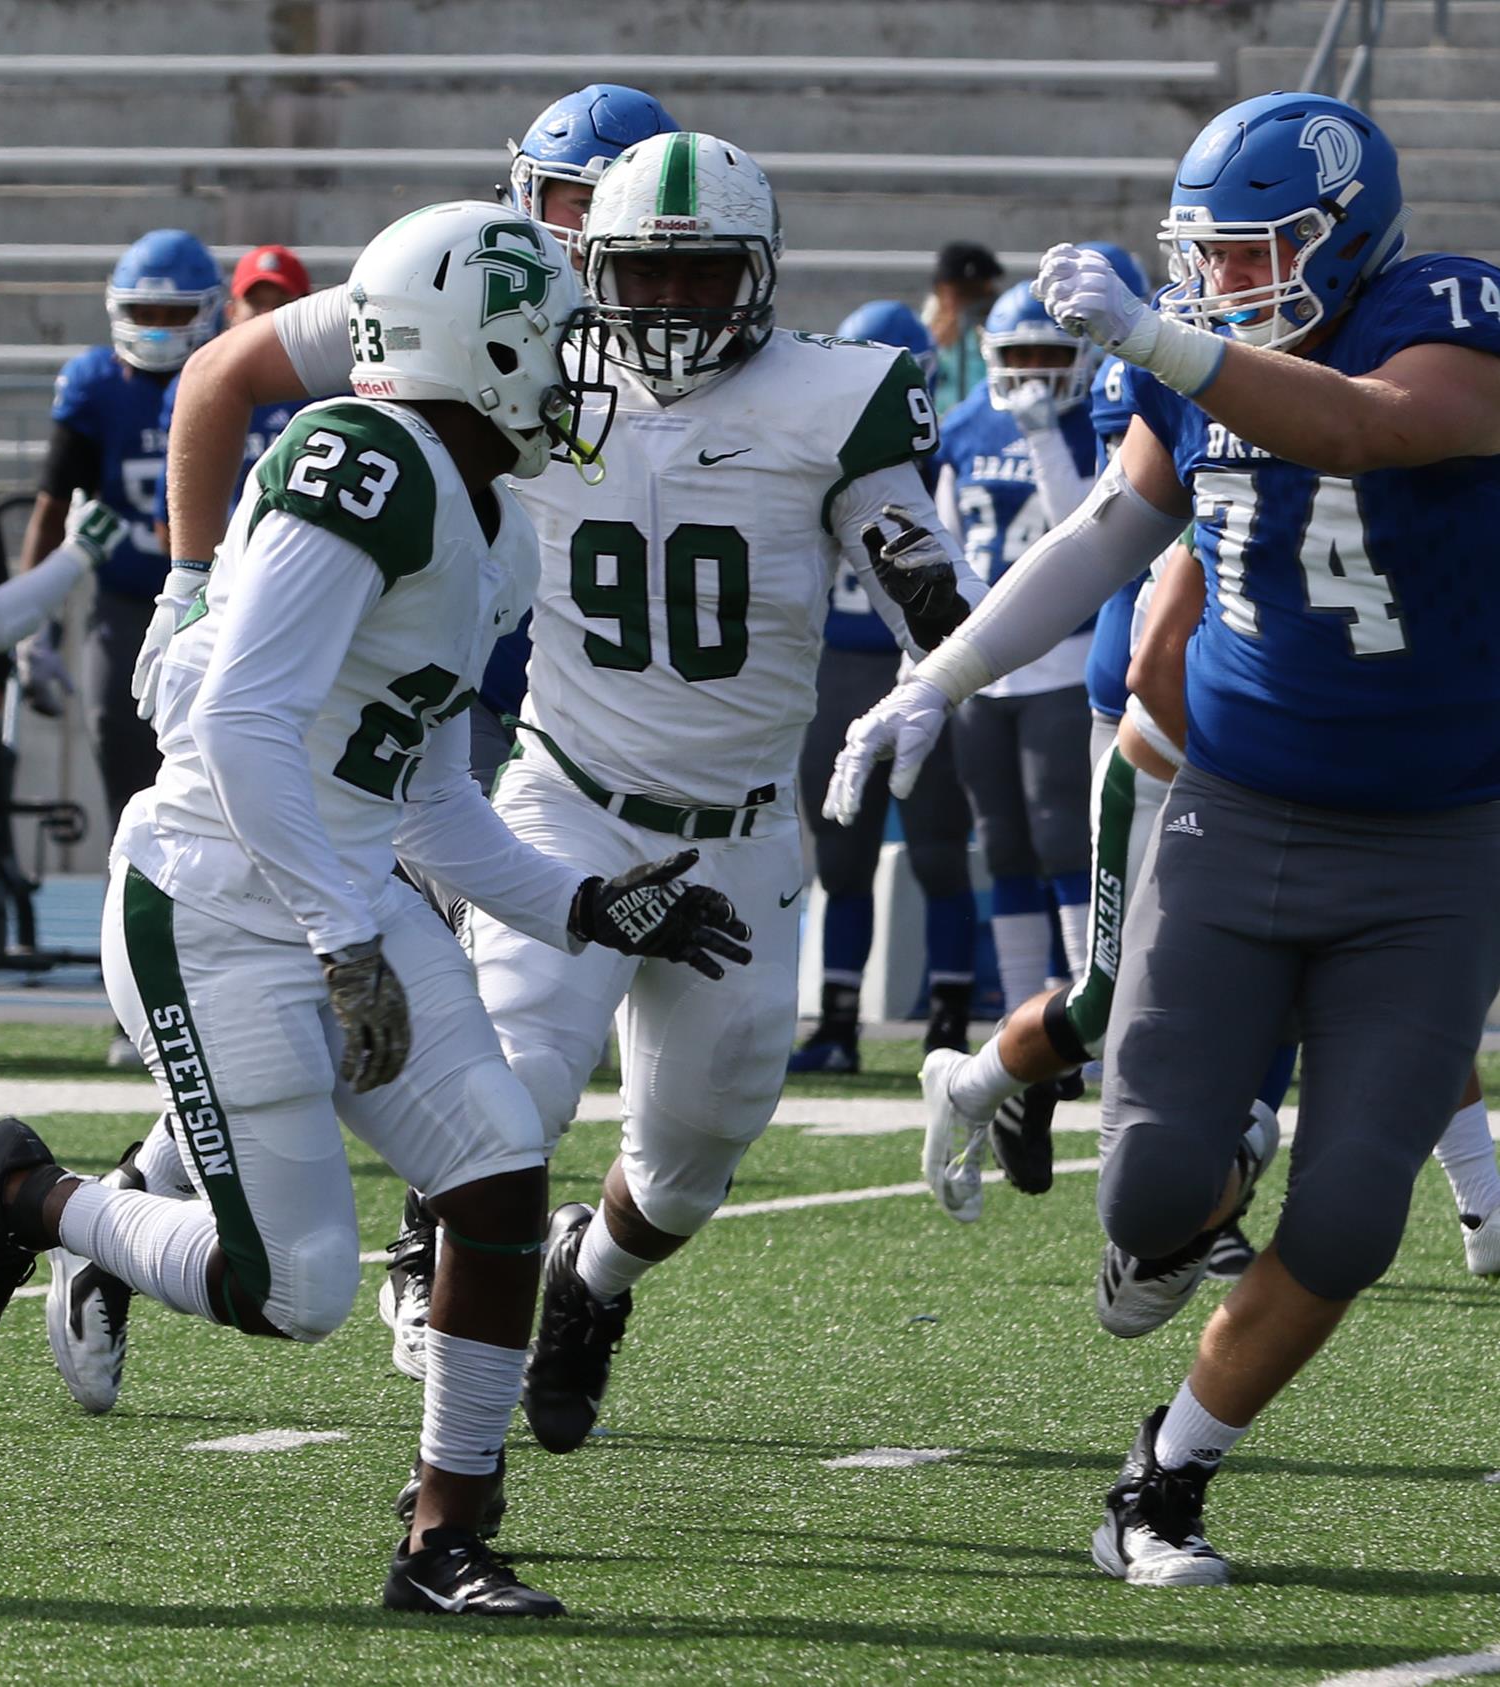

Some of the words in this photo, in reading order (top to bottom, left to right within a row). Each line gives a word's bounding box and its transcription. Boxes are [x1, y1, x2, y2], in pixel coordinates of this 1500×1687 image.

[654, 218, 698, 232] Riddell
[350, 317, 386, 364] 23
[907, 387, 938, 451] 9
[286, 430, 400, 520] 23
[971, 455, 1036, 482] DRAK
[569, 518, 751, 683] 90
[1193, 471, 1407, 656] 74
[1164, 823, 1205, 837] adidas
[1094, 867, 1123, 983] STETSON
[153, 1003, 235, 1178] STETSON
